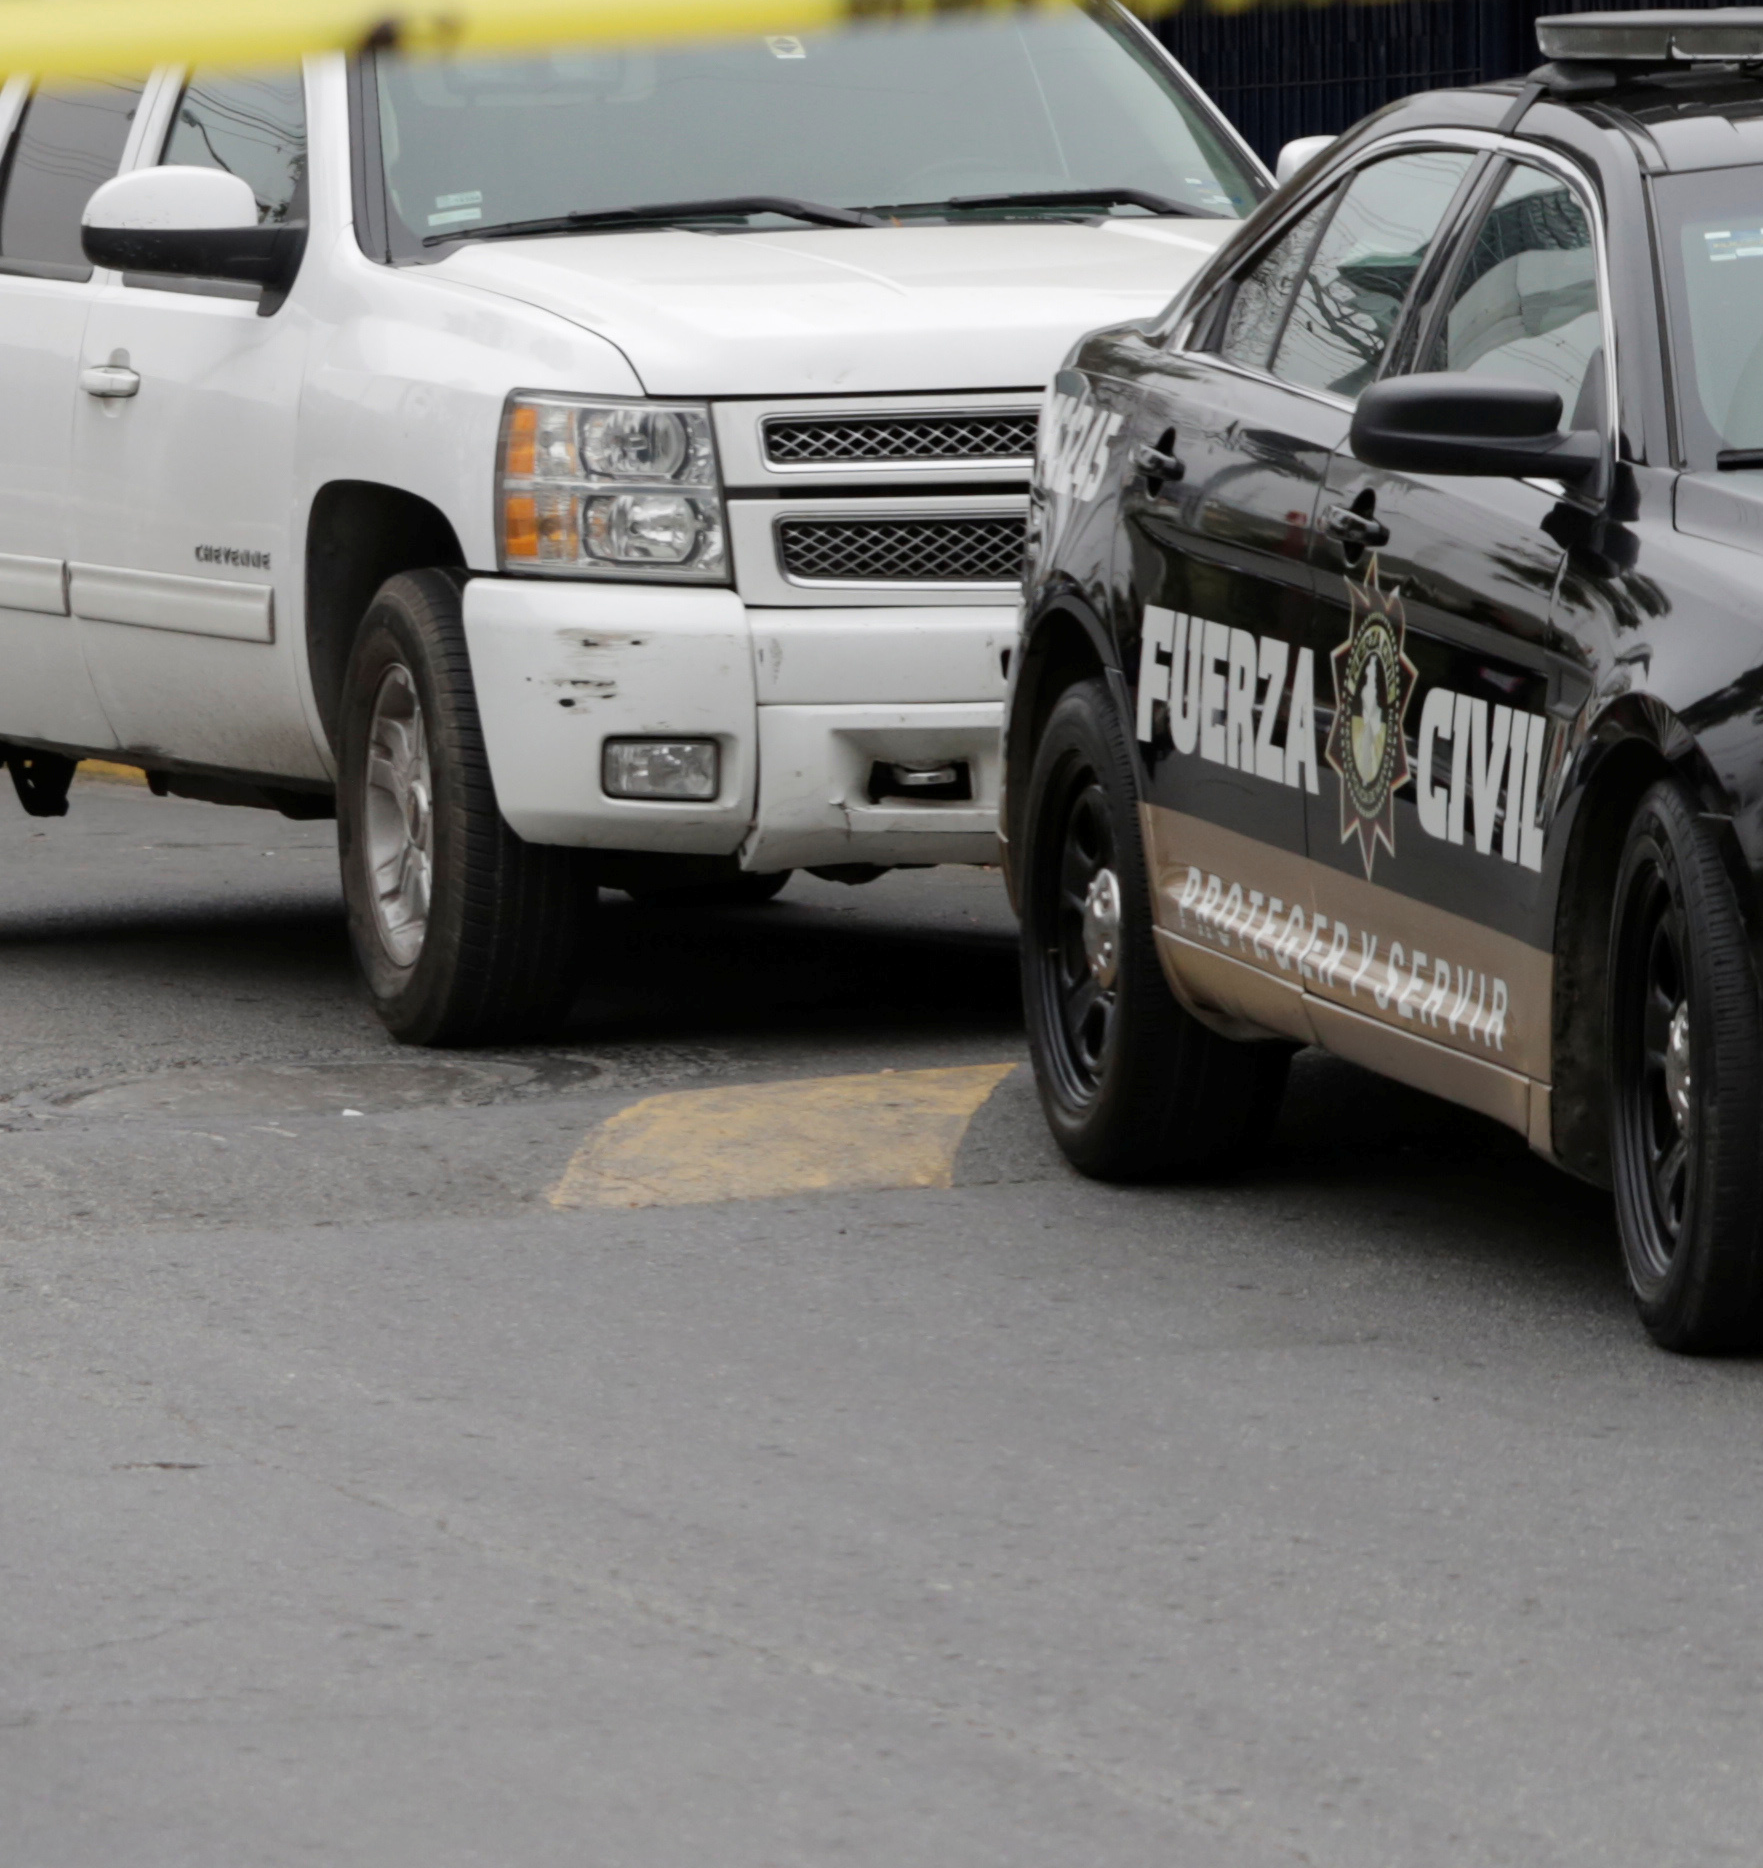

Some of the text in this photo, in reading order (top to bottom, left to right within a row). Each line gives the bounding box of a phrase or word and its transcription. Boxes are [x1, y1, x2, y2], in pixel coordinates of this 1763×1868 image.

[1136, 604, 1320, 796] FUERZA
[1416, 687, 1546, 873] CIVIL
[1352, 930, 1378, 997] Y
[1374, 940, 1508, 1051] SERVIR
